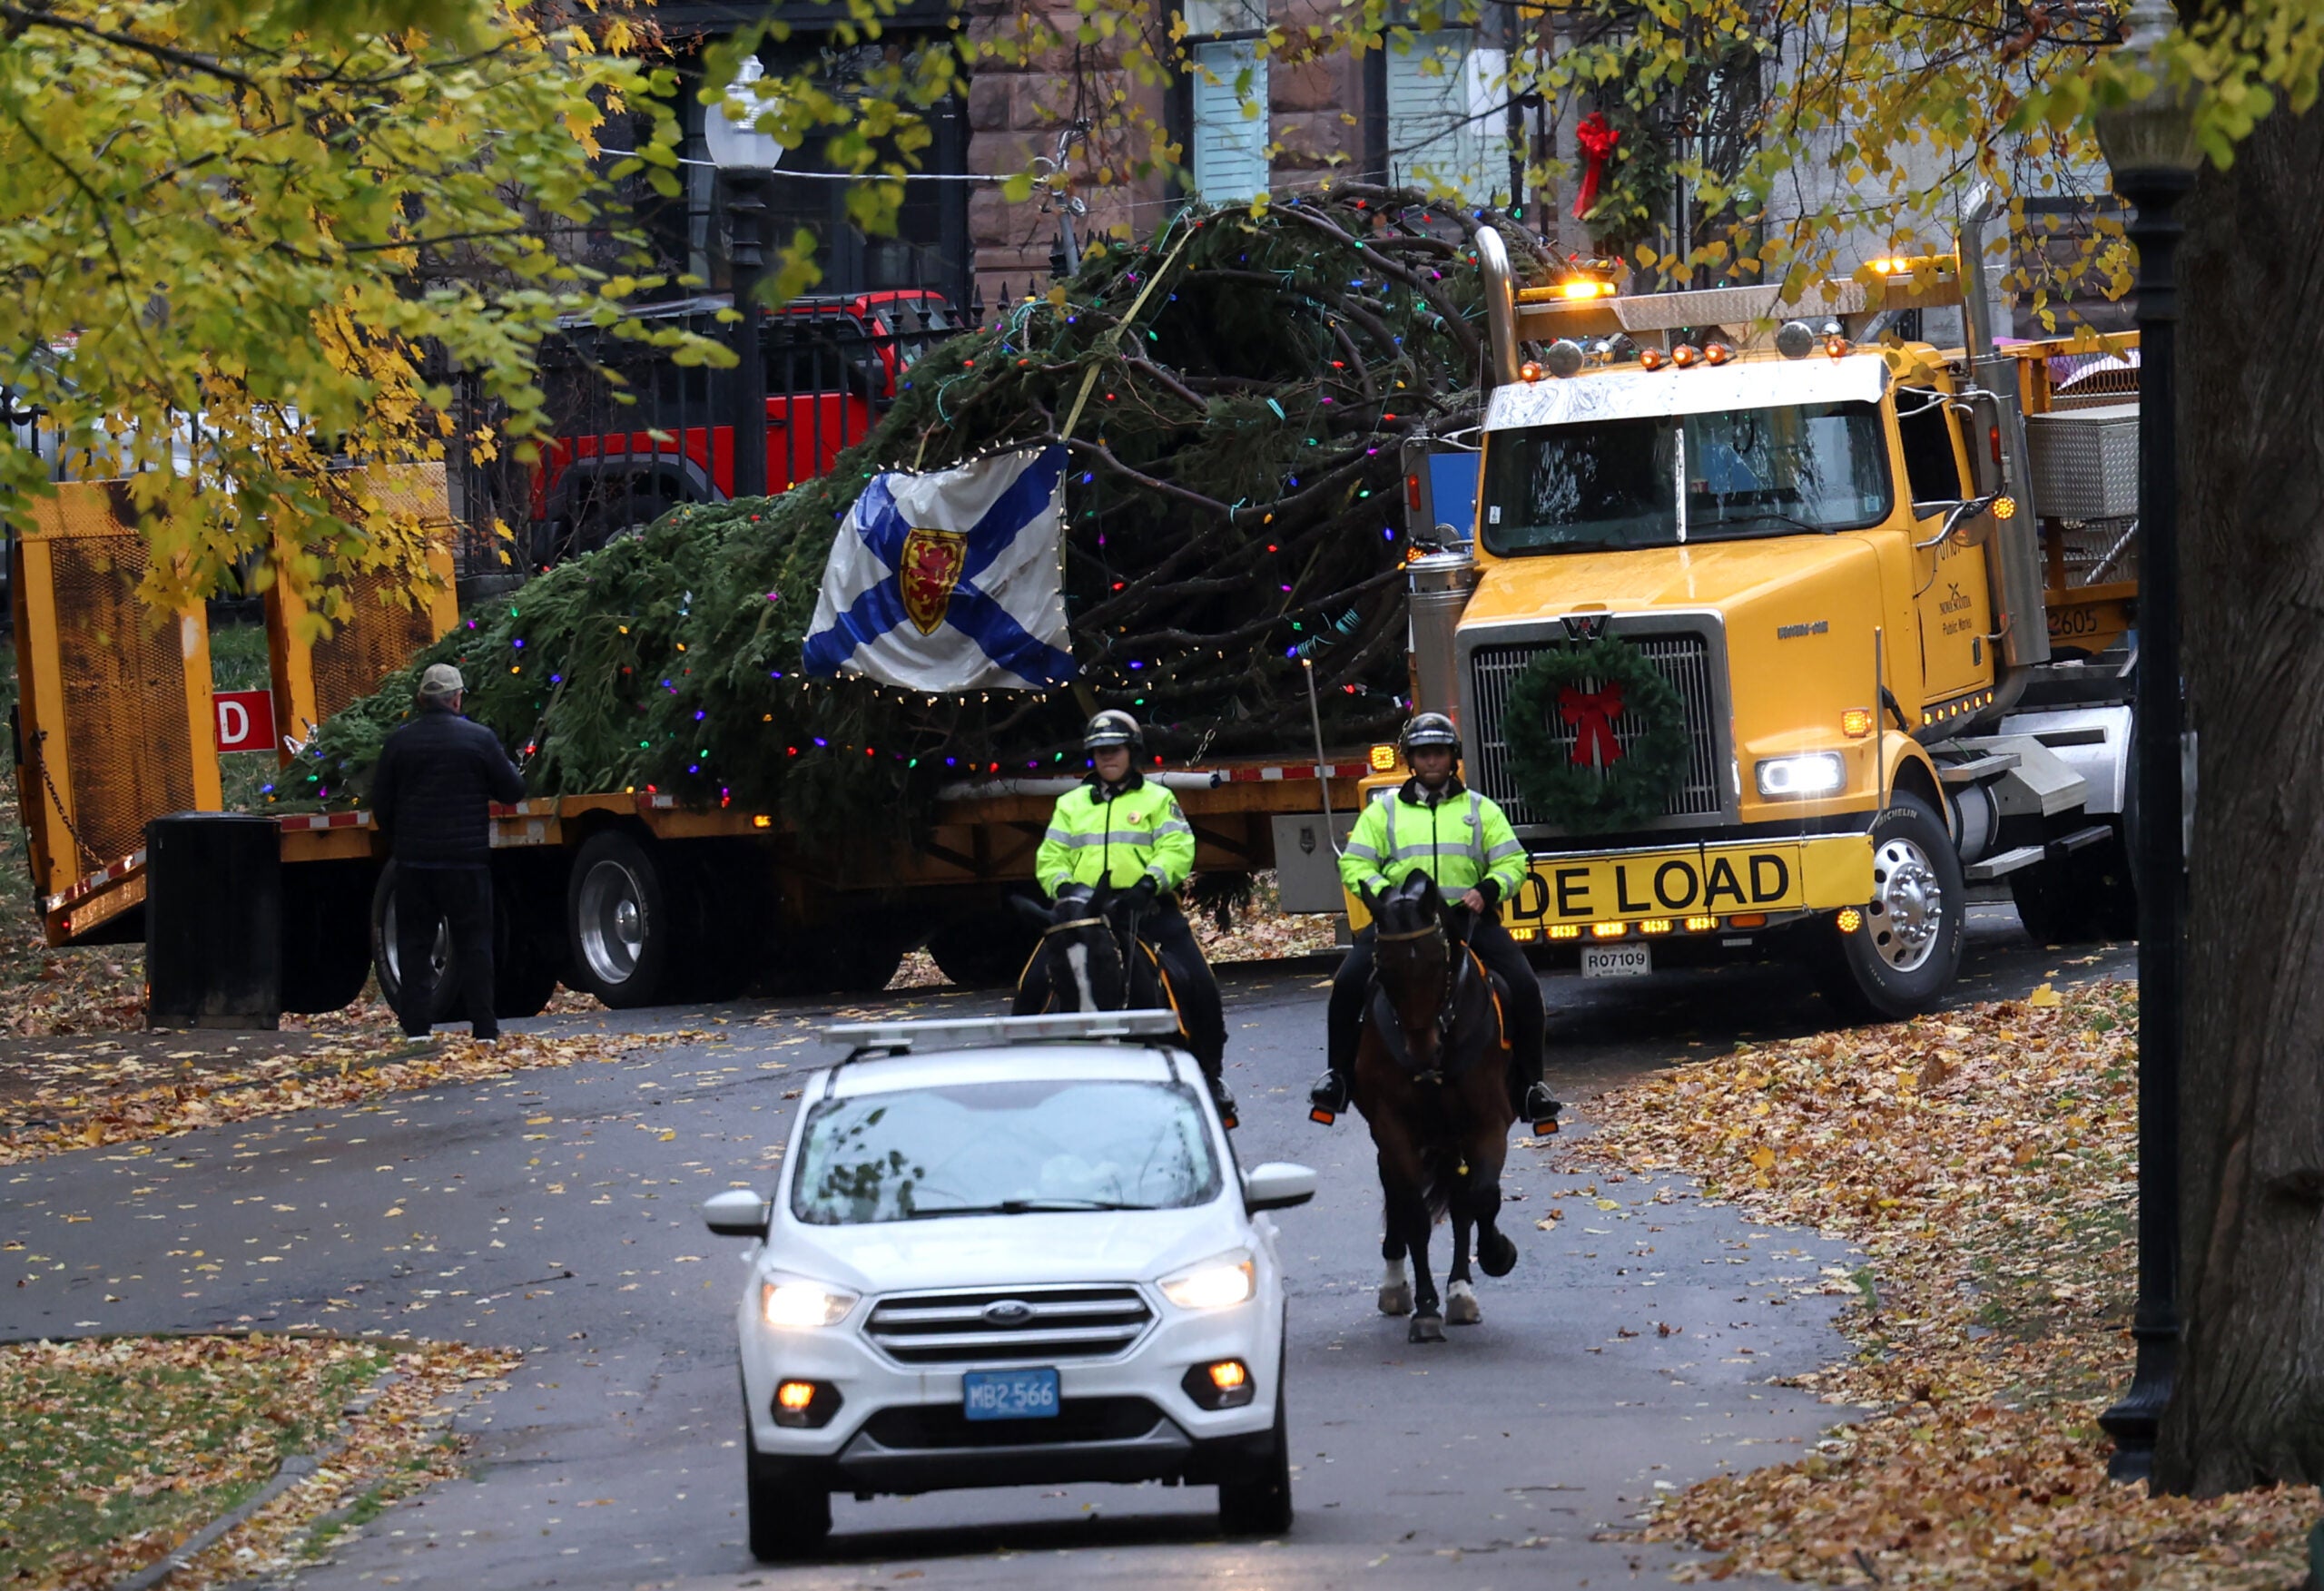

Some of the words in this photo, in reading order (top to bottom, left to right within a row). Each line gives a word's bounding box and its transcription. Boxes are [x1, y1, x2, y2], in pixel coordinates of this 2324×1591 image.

[218, 701, 250, 744] D
[1512, 868, 1593, 920] DE
[1616, 854, 1788, 913] LOAD
[1589, 952, 1645, 968] R07109
